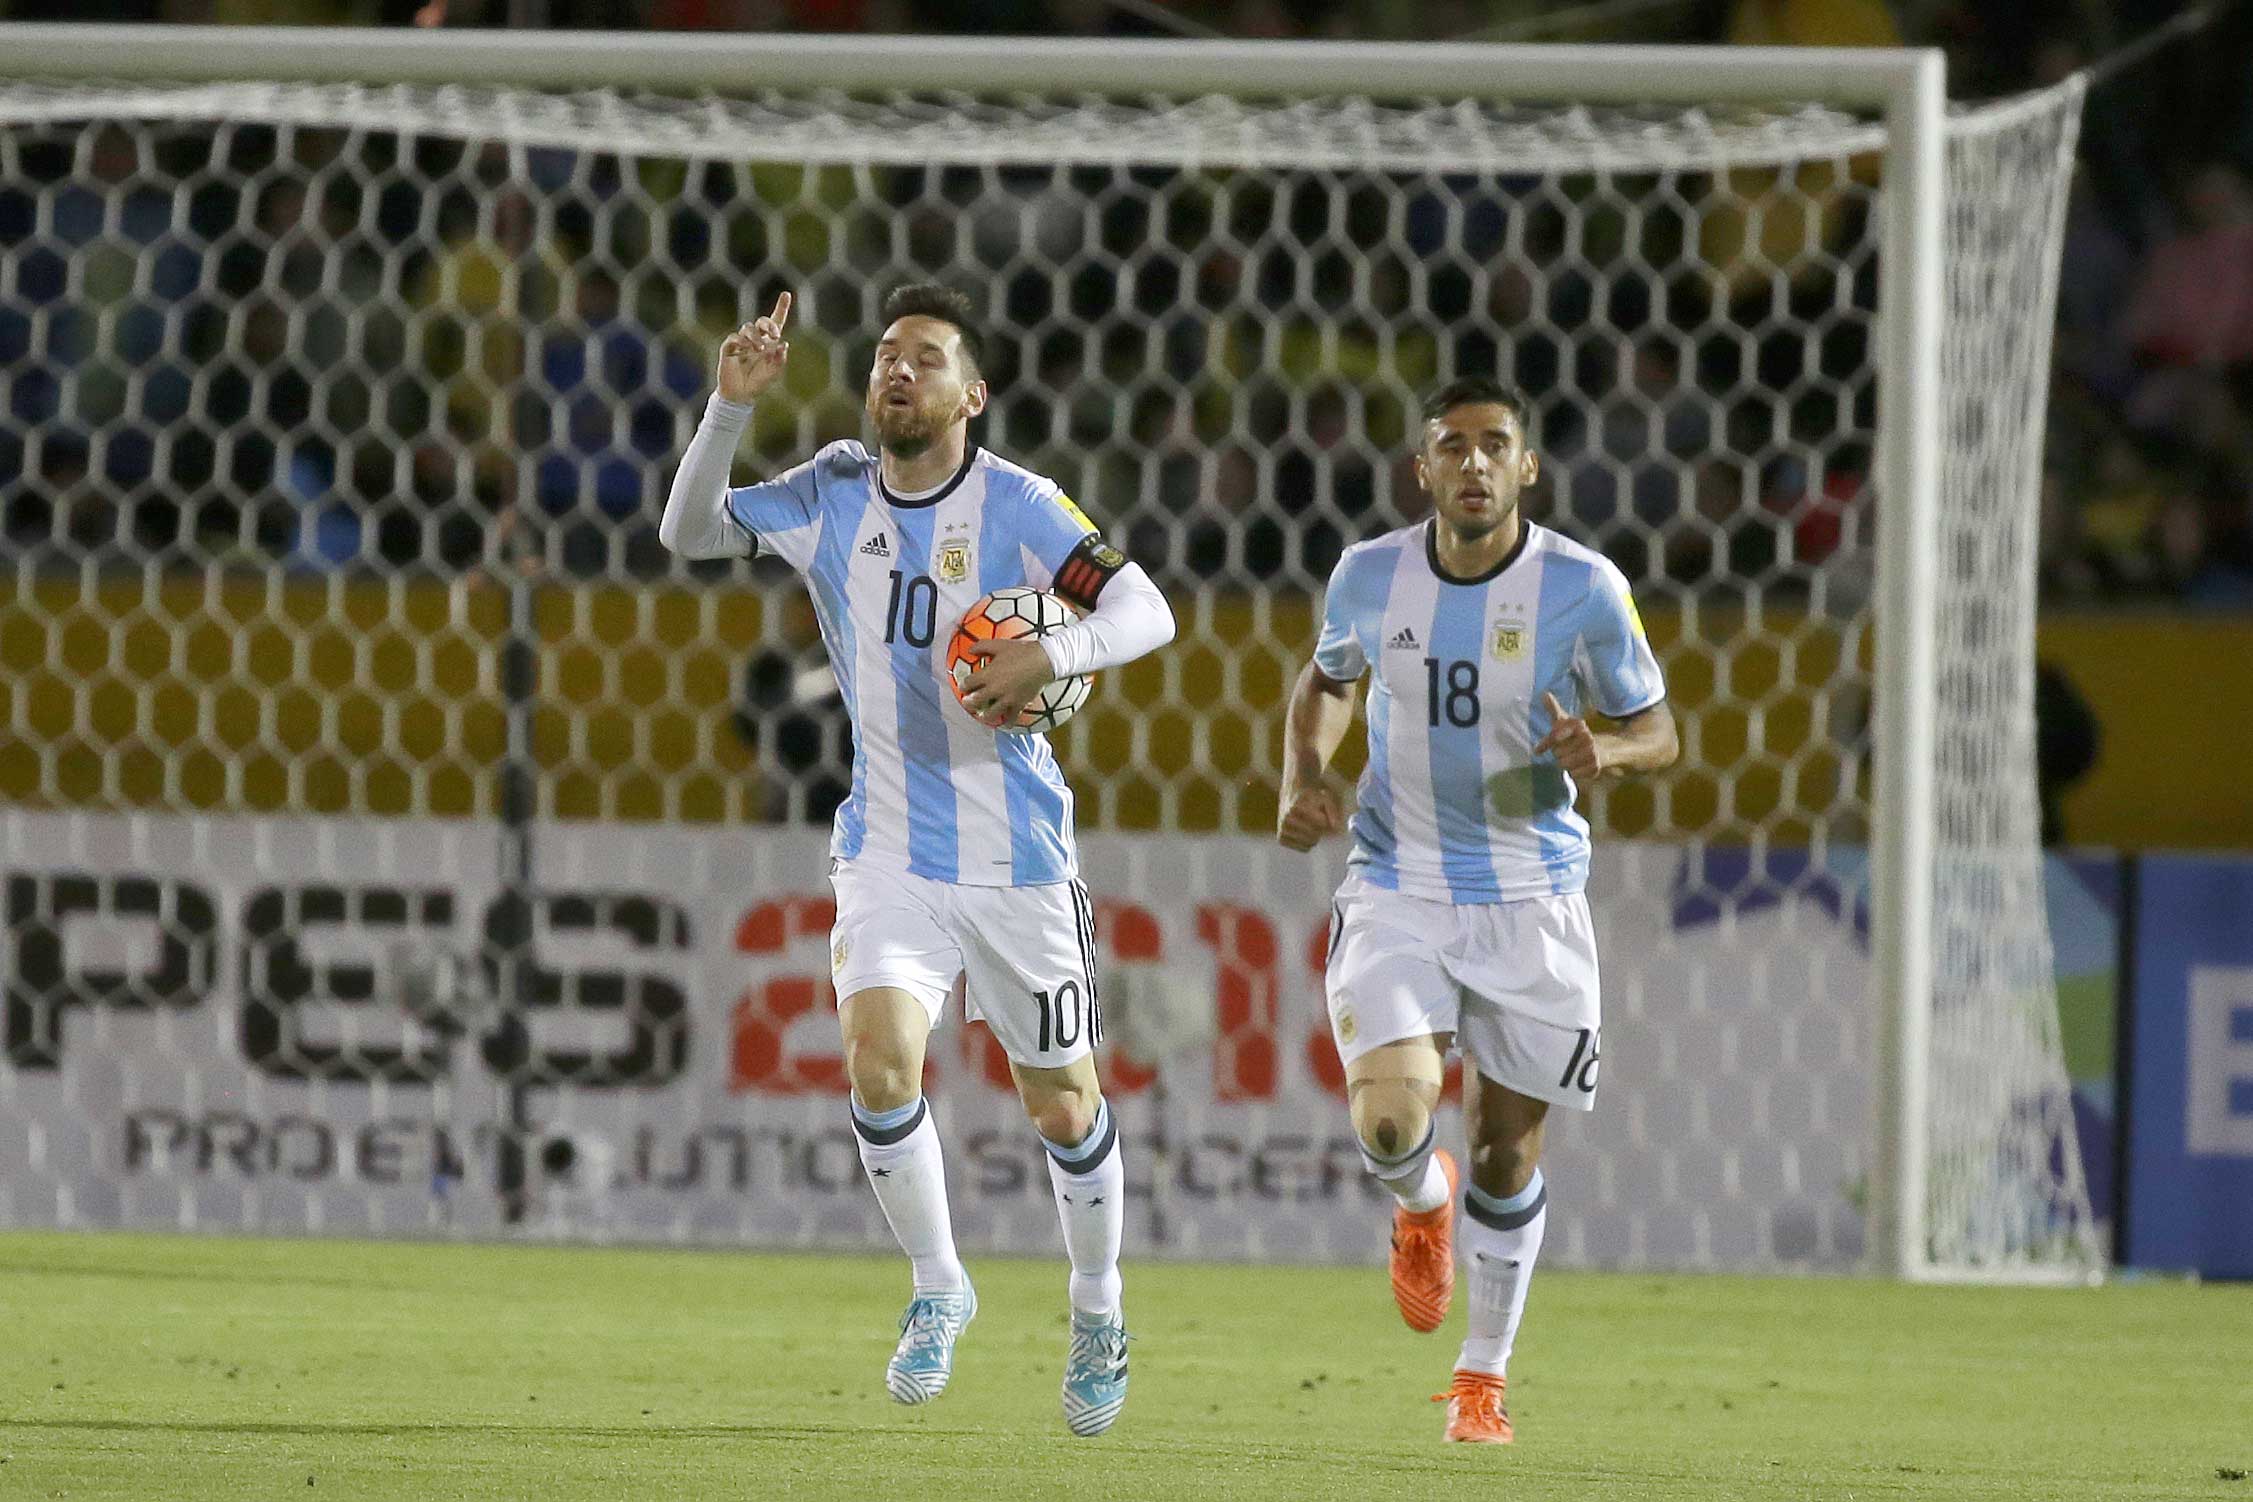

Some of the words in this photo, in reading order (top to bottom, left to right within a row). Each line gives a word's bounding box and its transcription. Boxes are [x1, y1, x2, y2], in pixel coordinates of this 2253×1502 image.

[885, 570, 937, 648] 10
[1424, 658, 1481, 729] 18
[4, 873, 688, 1088] PES
[728, 897, 1466, 1100] 21
[1034, 980, 1080, 1052] 10
[122, 1110, 338, 1176] PRO
[964, 1132, 1392, 1200] SCCER
